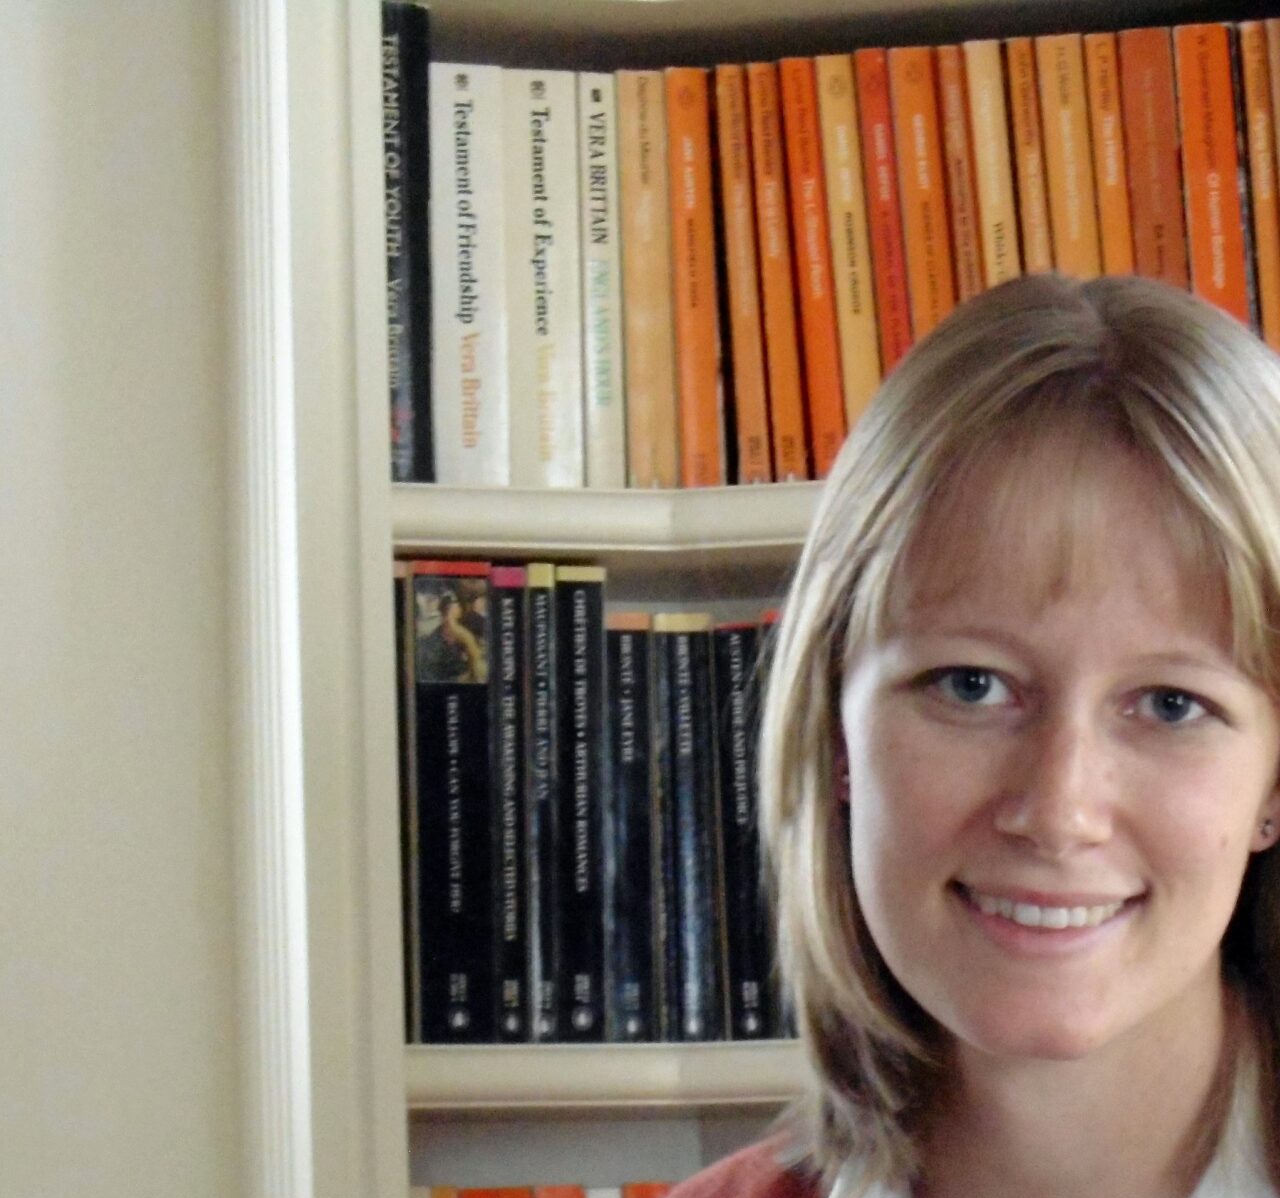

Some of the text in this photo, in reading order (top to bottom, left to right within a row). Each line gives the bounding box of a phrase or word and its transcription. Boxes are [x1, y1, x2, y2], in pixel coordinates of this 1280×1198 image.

[383, 34, 400, 144] TESTAMENT
[531, 108, 550, 201] Testament
[588, 112, 606, 158] VERA
[385, 152, 401, 179] OF
[1206, 172, 1218, 187] Of
[385, 186, 401, 256] YOUTH
[534, 208, 552, 225] of
[590, 164, 608, 244] BRITTAIN
[1208, 191, 1222, 232] Human
[453, 99, 482, 448] Testament of Friendship Vera Brittain
[531, 234, 554, 336] Experience
[1210, 236, 1226, 289] Bondage
[387, 279, 402, 317] Vera
[537, 342, 556, 383] Vera
[572, 659, 586, 674] DE
[730, 634, 742, 682] AUSTEN
[532, 594, 548, 800] MAUPASSANT PIERRE AND JEAN
[572, 680, 586, 728] TROYES
[620, 699, 633, 730] JANE
[621, 732, 634, 762] EYRE
[678, 696, 691, 756] VILLETTE
[733, 731, 746, 758] AND
[501, 597, 518, 940] KATE CHOPIN THE AWAKENING AND SELECTED STORIES
[572, 741, 587, 816] ARTHURIAN
[734, 760, 748, 826] PREJUDICE
[446, 694, 462, 914] TROLLOPE CAN YOU FORGIVE HER?
[574, 820, 588, 892] ROMANCES
